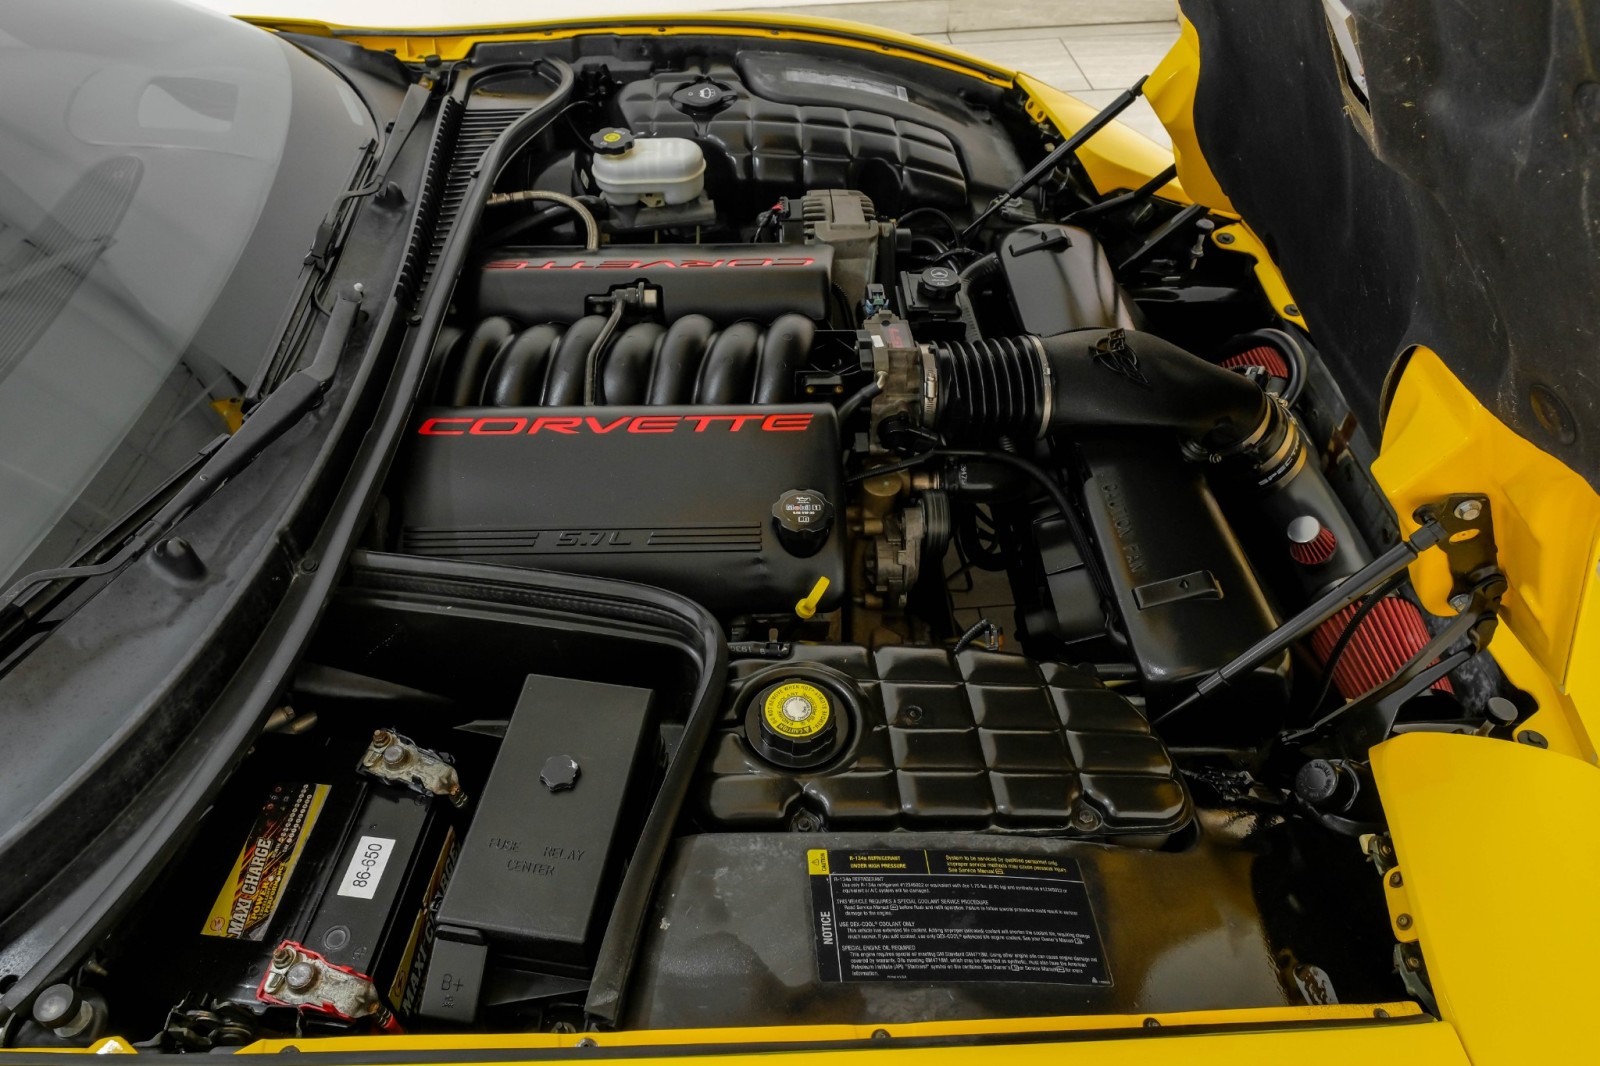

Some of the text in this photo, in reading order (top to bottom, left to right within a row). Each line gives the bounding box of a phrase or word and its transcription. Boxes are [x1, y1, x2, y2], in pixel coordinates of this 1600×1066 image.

[482, 257, 816, 270] CORVETTE
[418, 413, 814, 435] CORVETTE
[556, 531, 632, 546] 5.7L
[1101, 484, 1145, 573] CAUTION FAN
[488, 838, 585, 861] FUSE RELAY
[352, 843, 383, 888] 86-650
[507, 859, 555, 876] CENTER
[228, 838, 272, 938] MAXI CHARGE
[252, 880, 270, 921] POWER
[820, 911, 834, 945] NOTICE
[441, 973, 464, 992] B+
